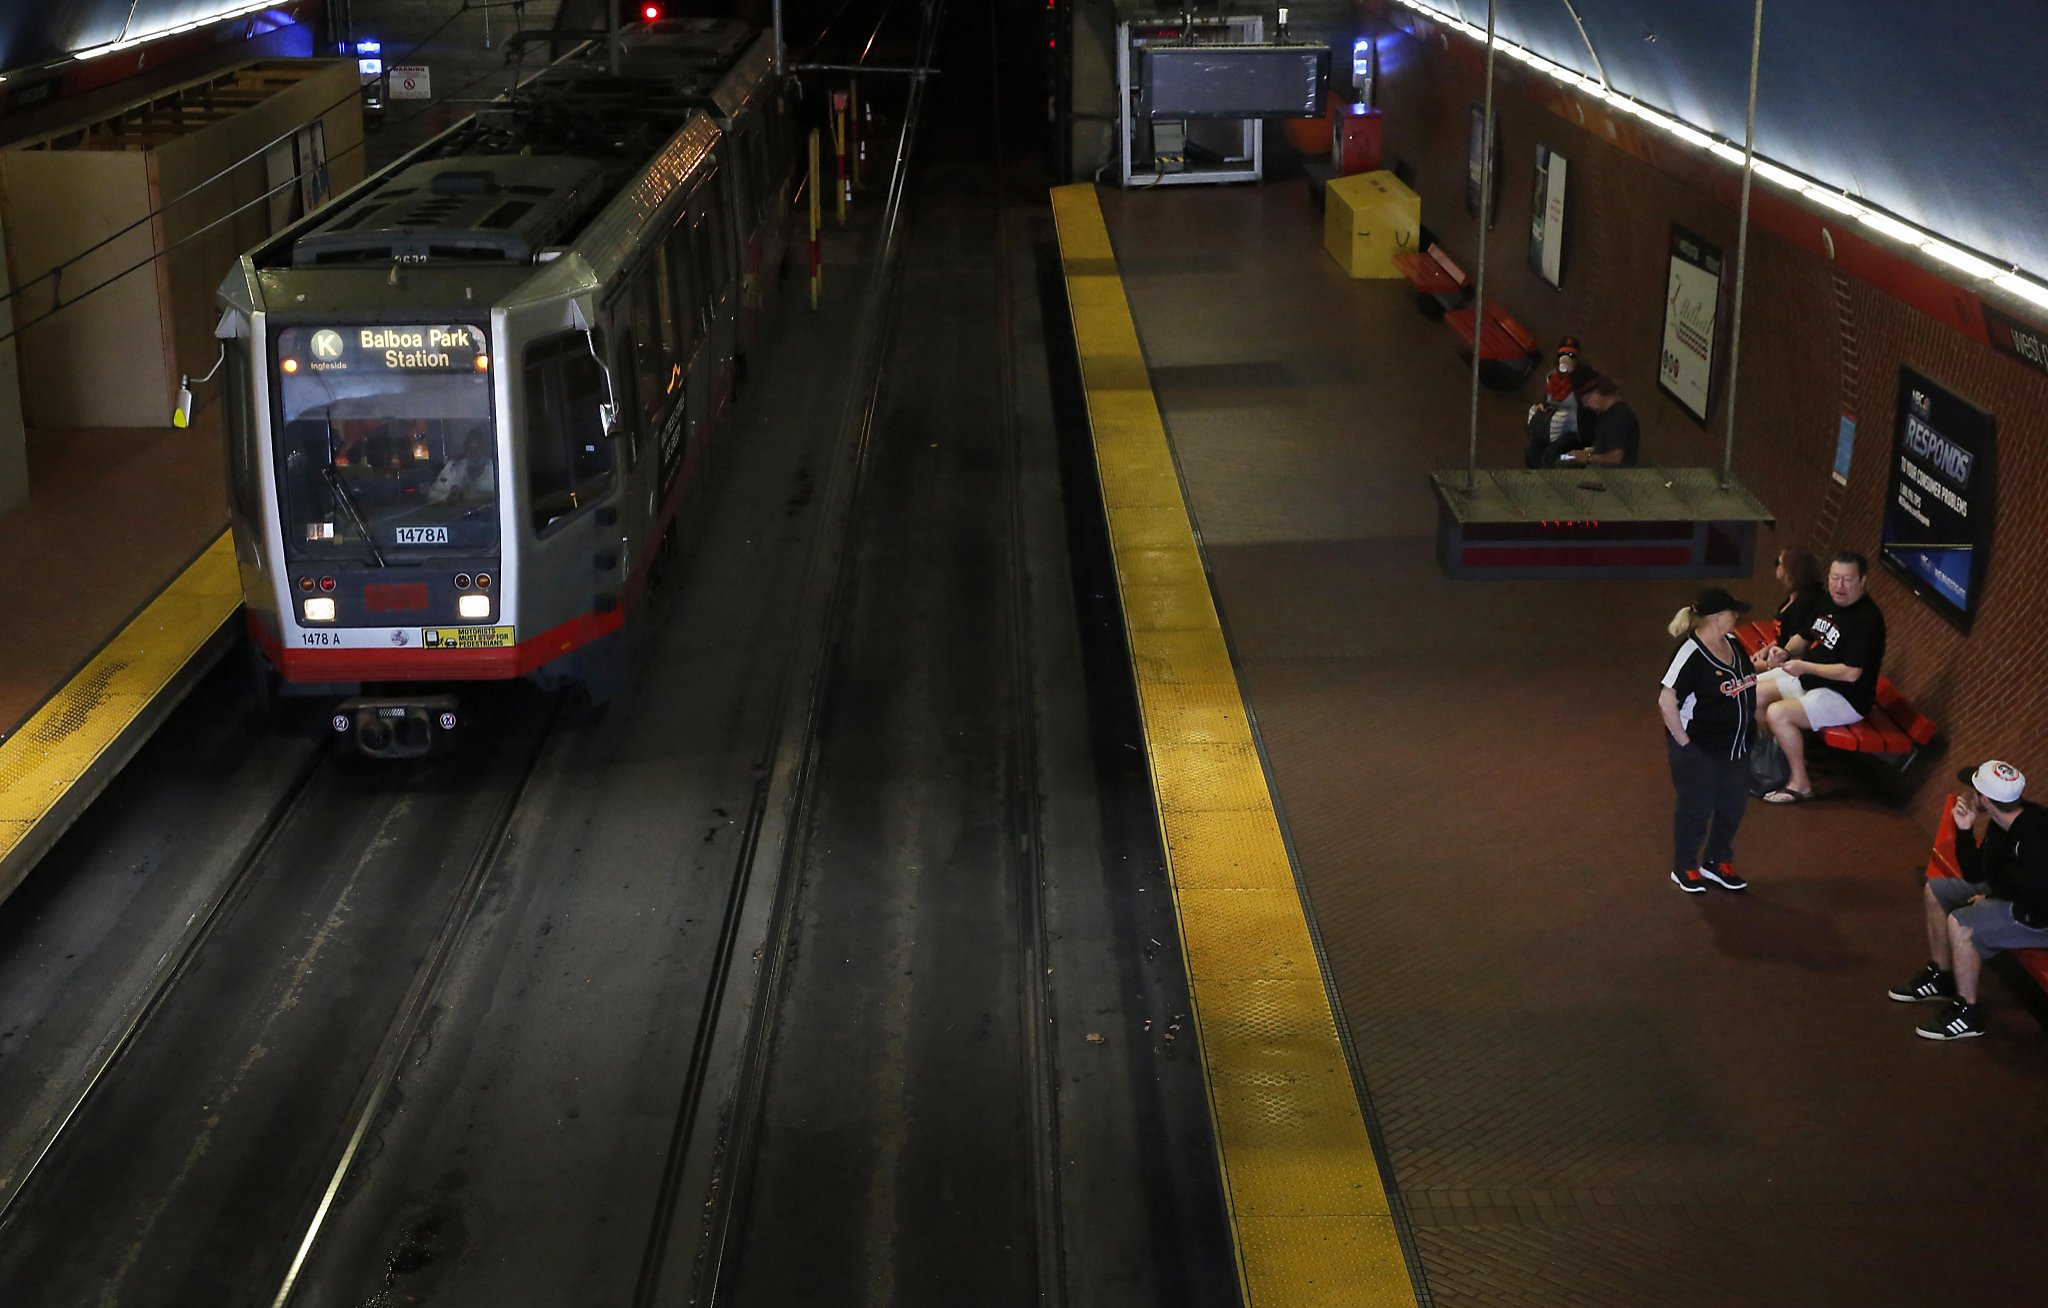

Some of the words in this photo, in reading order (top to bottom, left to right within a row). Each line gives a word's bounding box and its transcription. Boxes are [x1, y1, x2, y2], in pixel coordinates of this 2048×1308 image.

[317, 334, 338, 357] K
[360, 330, 423, 348] Balboa
[429, 328, 469, 347] Park
[310, 361, 347, 371] Ingleside
[385, 349, 449, 368] Station
[1906, 418, 1969, 484] RESPONDS
[1916, 468, 1942, 500] CONSUMER
[1941, 485, 1968, 518] PROBLEMS
[398, 528, 447, 543] 1478A
[302, 633, 329, 646] 1478
[332, 633, 341, 645] A
[458, 627, 496, 635] MOTORISTS
